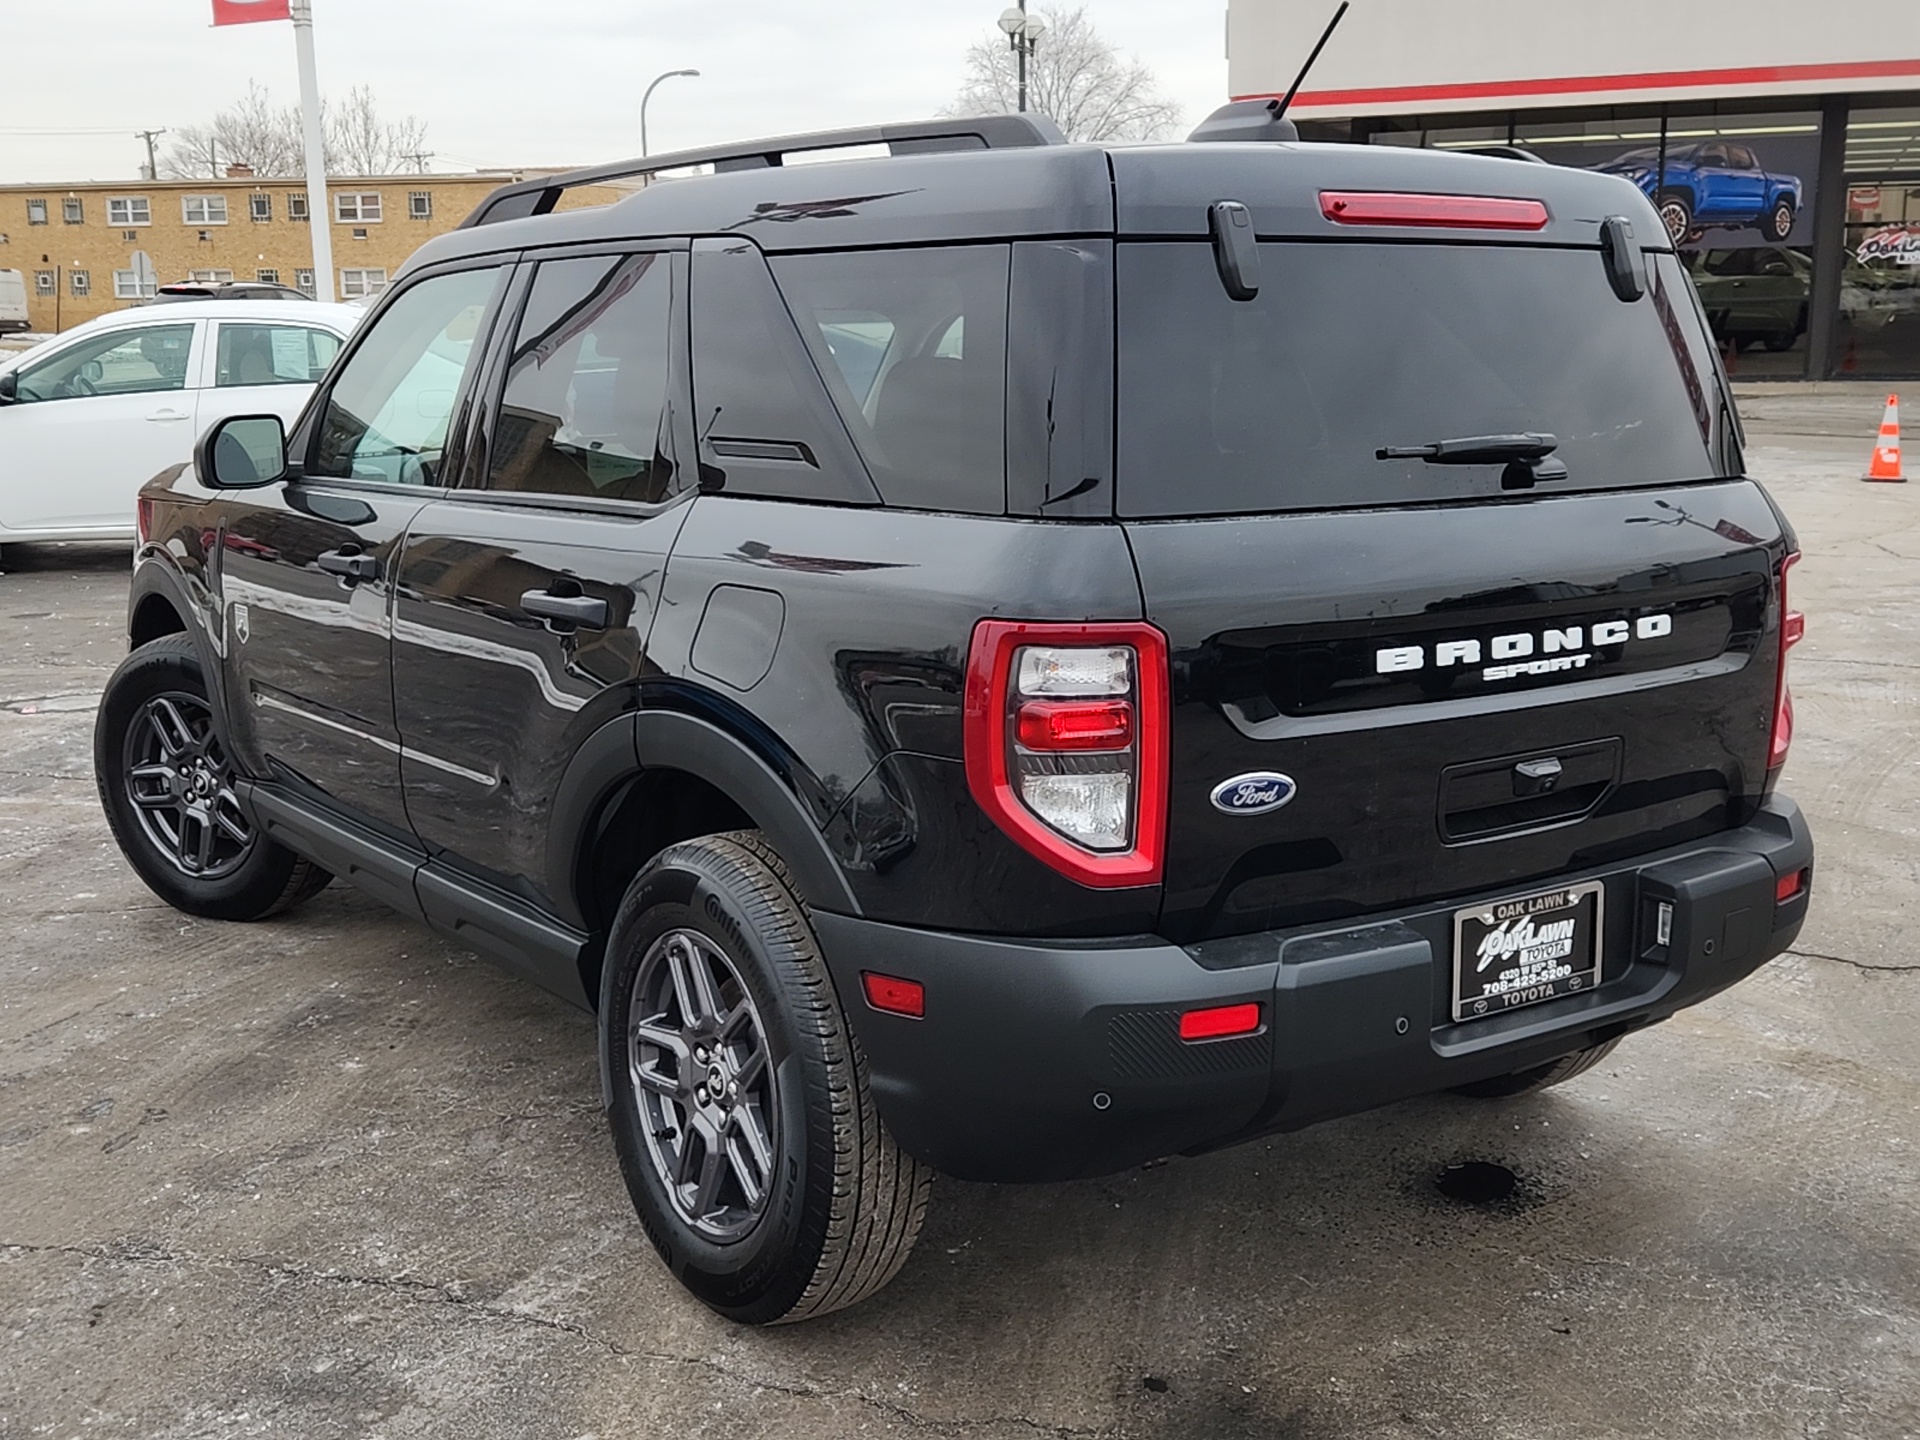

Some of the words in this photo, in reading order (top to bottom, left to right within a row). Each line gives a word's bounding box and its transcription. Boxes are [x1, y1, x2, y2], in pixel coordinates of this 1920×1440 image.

[1376, 614, 1672, 673] BRONCO
[1482, 653, 1592, 681] SPORT
[1232, 781, 1280, 806] Ford
[1497, 902, 1525, 918] OAK
[1528, 893, 1565, 911] LAWN
[1526, 942, 1566, 961] TOYOTA
[1482, 964, 1572, 995] 708-423-5200
[1499, 967, 1520, 980] 4320
[1502, 984, 1554, 1006] TOYOTA
